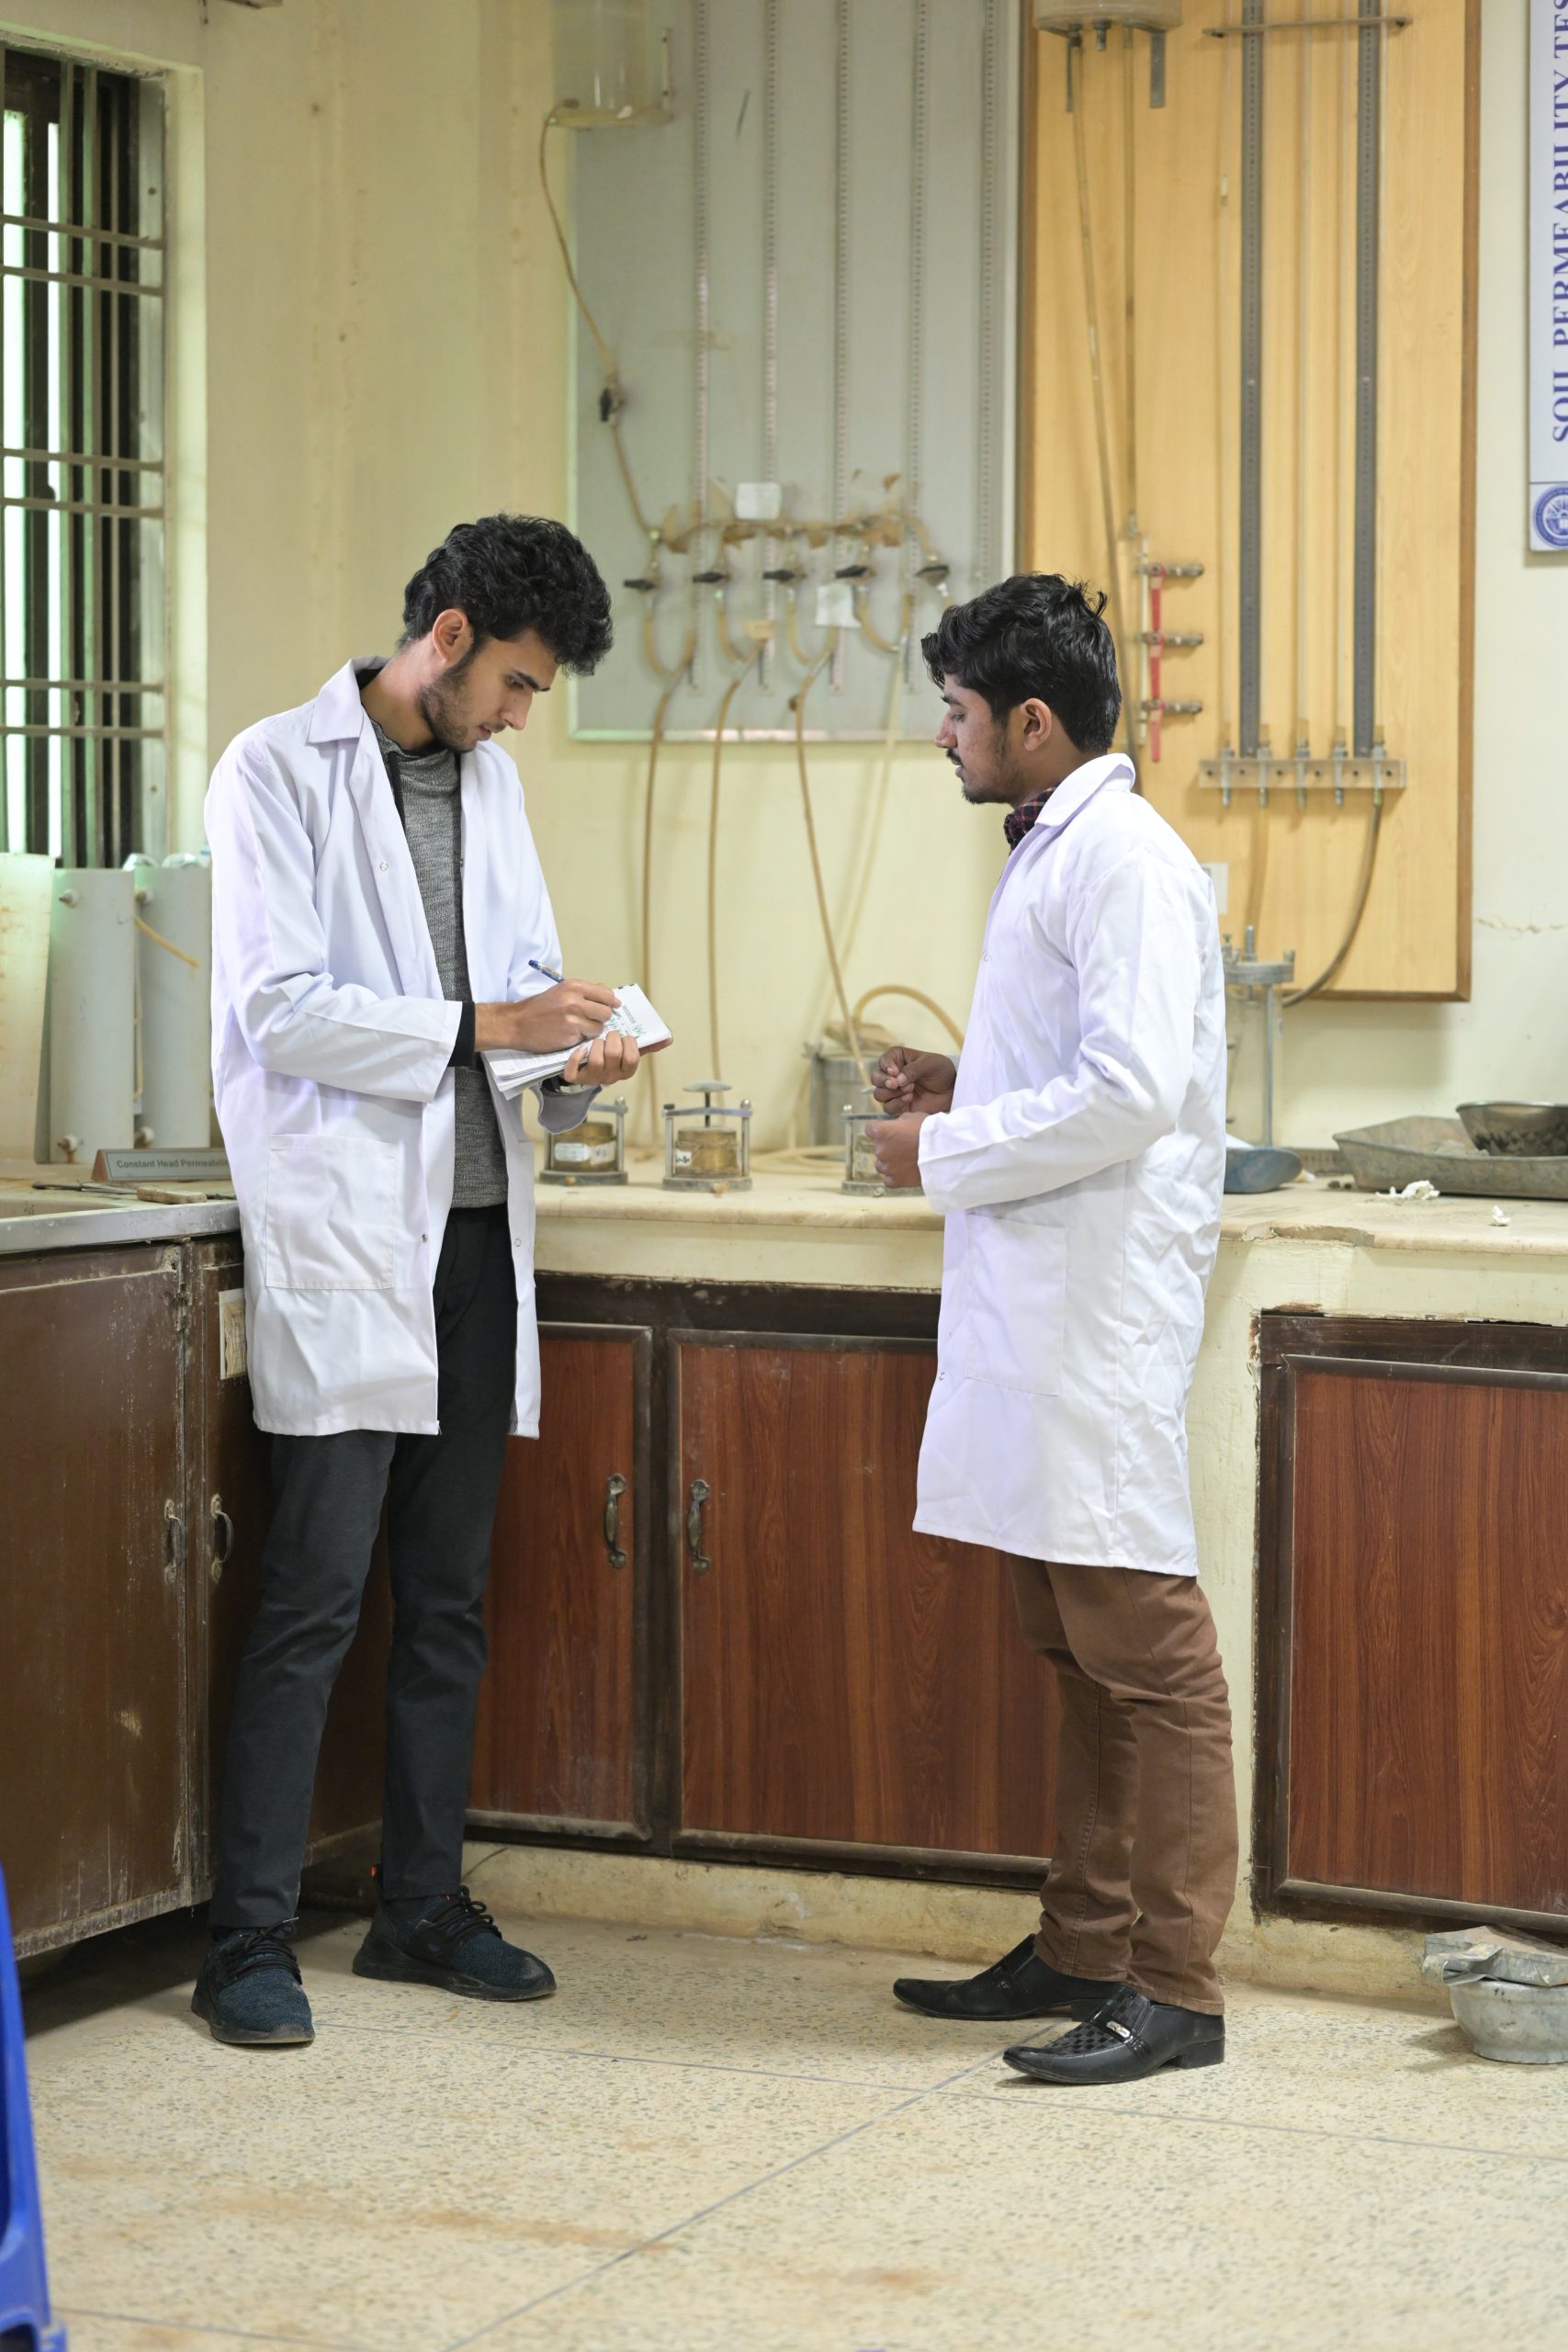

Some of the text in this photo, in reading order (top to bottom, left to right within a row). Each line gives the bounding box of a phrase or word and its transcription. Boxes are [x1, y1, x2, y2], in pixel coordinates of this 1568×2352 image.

[117, 1159, 228, 1169] Constant Head Permeabilit
